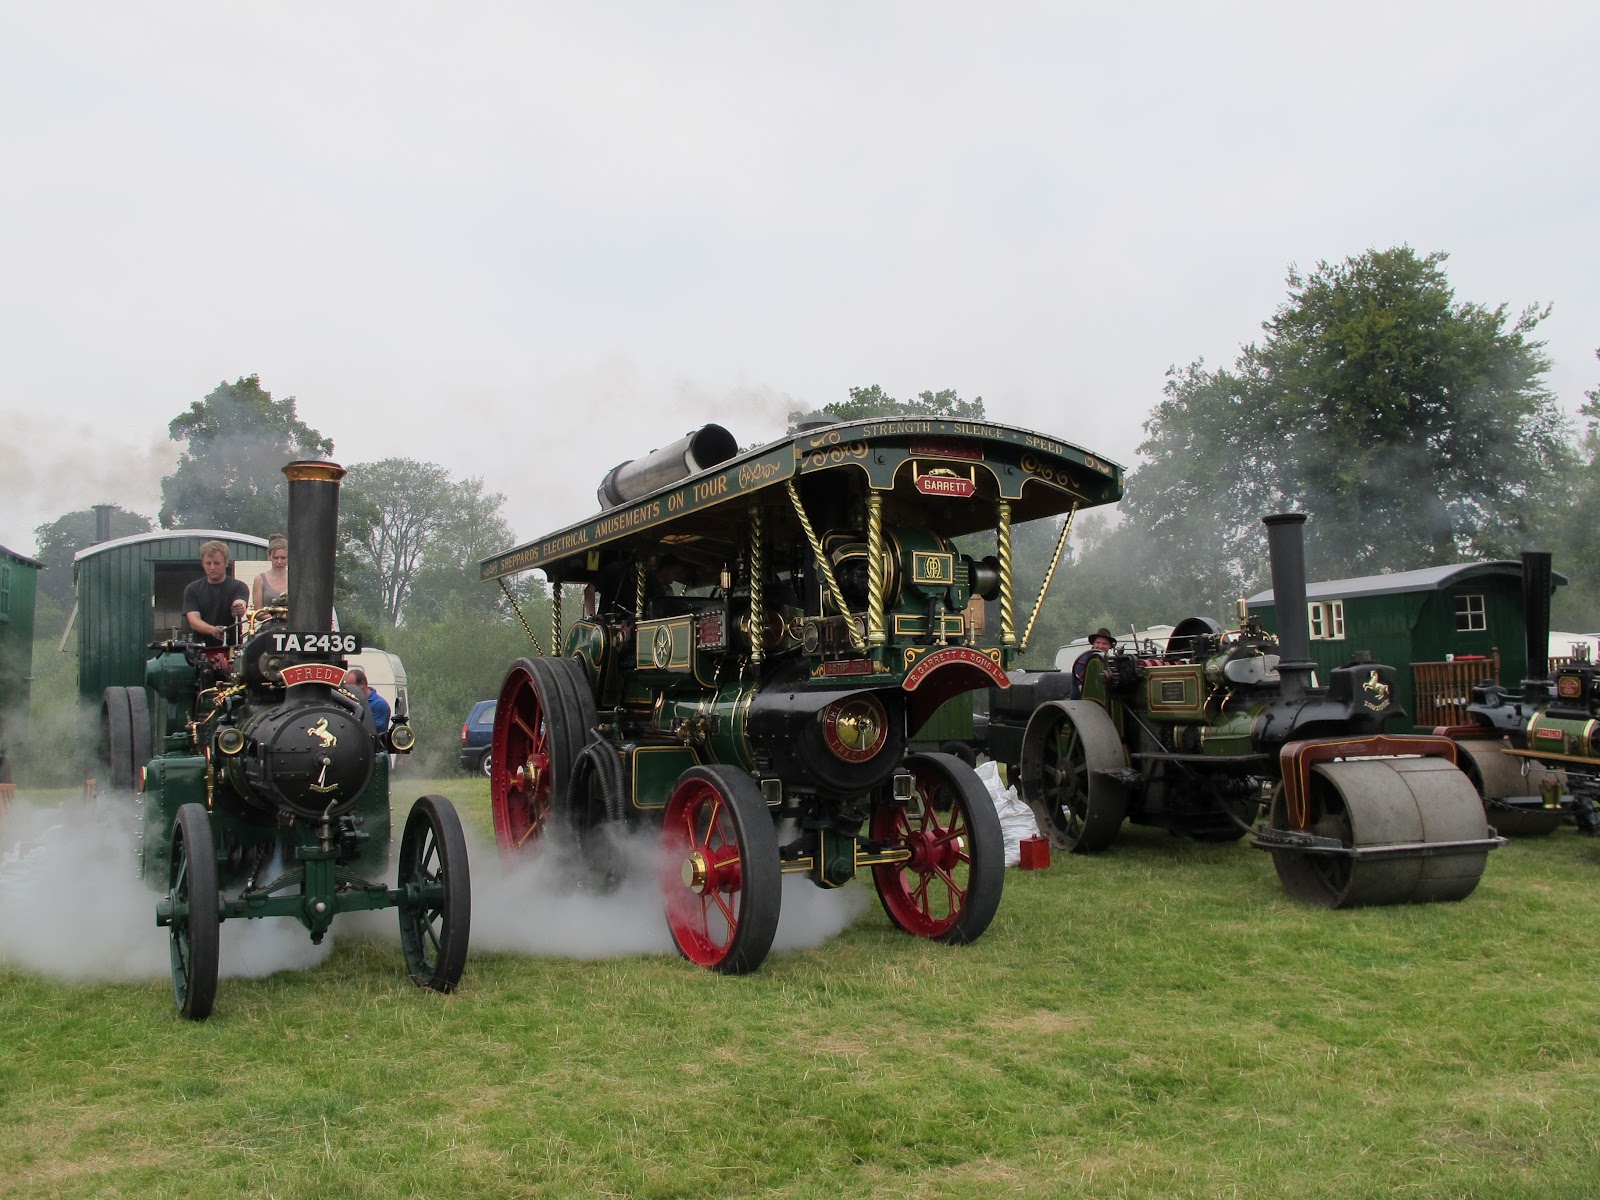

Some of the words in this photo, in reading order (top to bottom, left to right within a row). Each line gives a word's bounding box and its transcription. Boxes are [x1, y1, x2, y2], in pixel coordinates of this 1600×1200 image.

[863, 421, 931, 437] STRENGTH
[954, 423, 1004, 439] SILENCE
[1025, 435, 1063, 455] SPEED
[924, 480, 967, 492] GARRETT
[543, 530, 588, 556] ELECTRICAL
[595, 502, 660, 538] AMUSEMENTS
[668, 493, 685, 511] ON
[693, 475, 728, 502] TOUR
[295, 667, 332, 680] FRED
[918, 651, 957, 674] GARRETT
[960, 651, 967, 659] &
[970, 653, 992, 670] SONS
